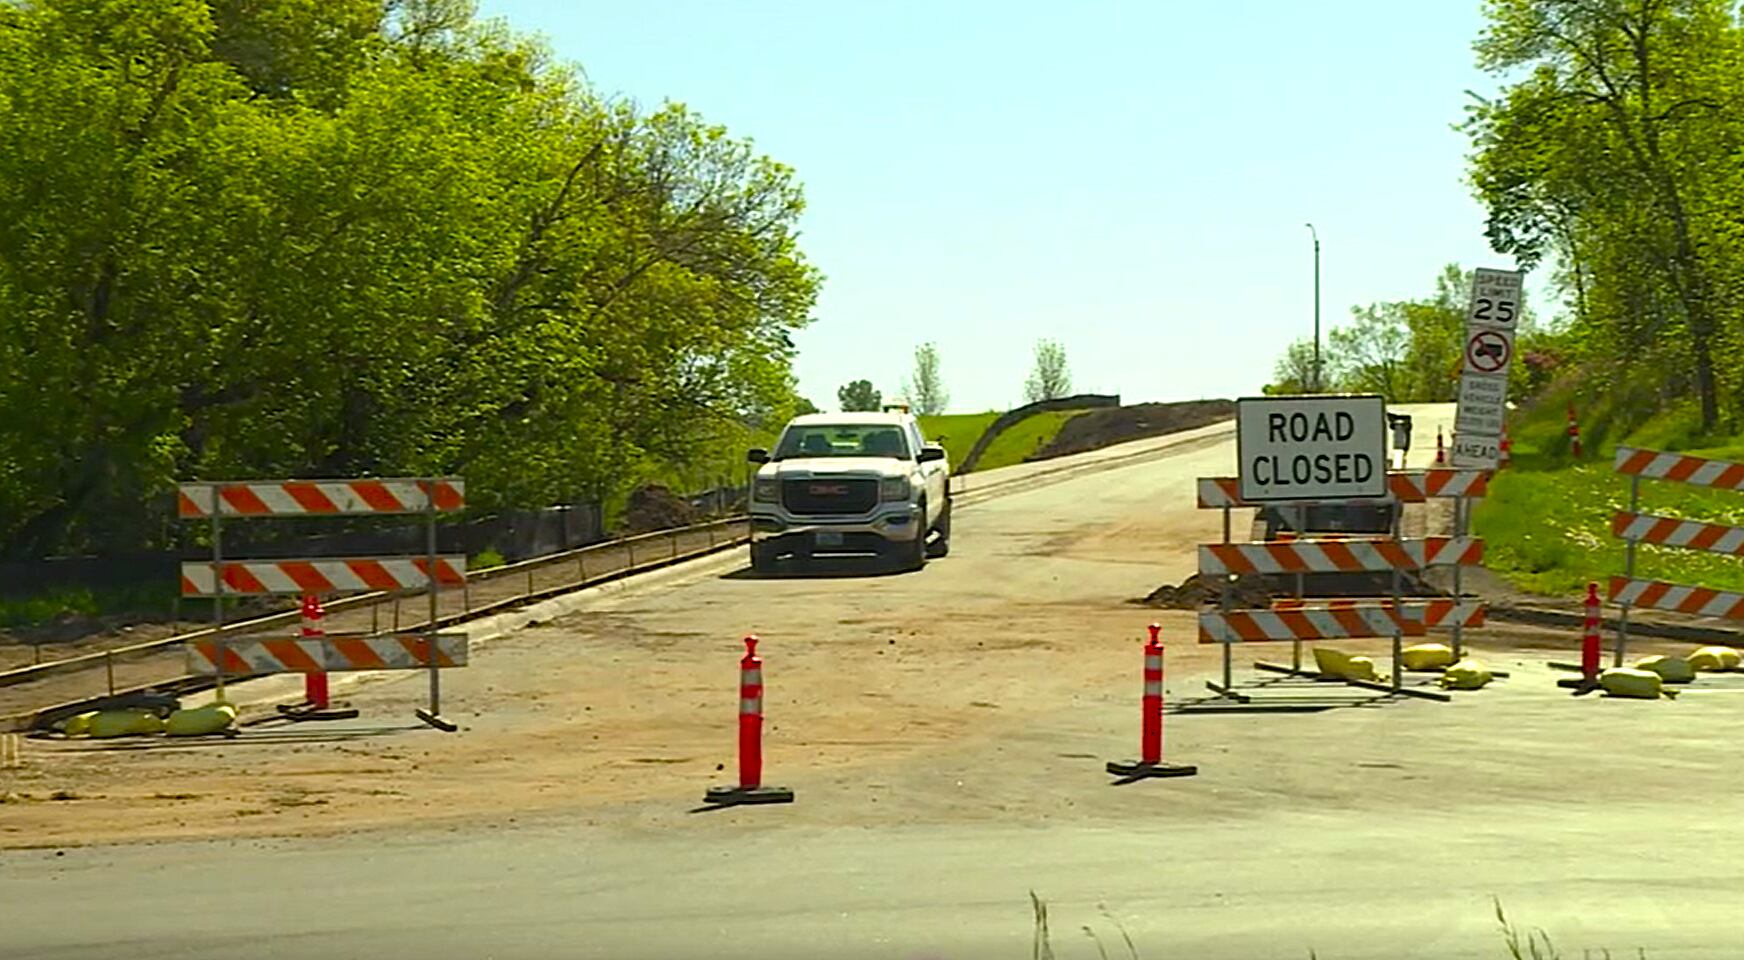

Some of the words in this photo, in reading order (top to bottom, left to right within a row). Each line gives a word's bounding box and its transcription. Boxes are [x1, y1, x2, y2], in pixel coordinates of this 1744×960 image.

[1479, 273, 1519, 288] SPEED
[1479, 286, 1514, 299] LIMIT
[1474, 299, 1514, 322] 25
[1269, 411, 1354, 442] ROAD
[1455, 443, 1499, 460] AHEAD
[1253, 453, 1373, 486] CLOSED
